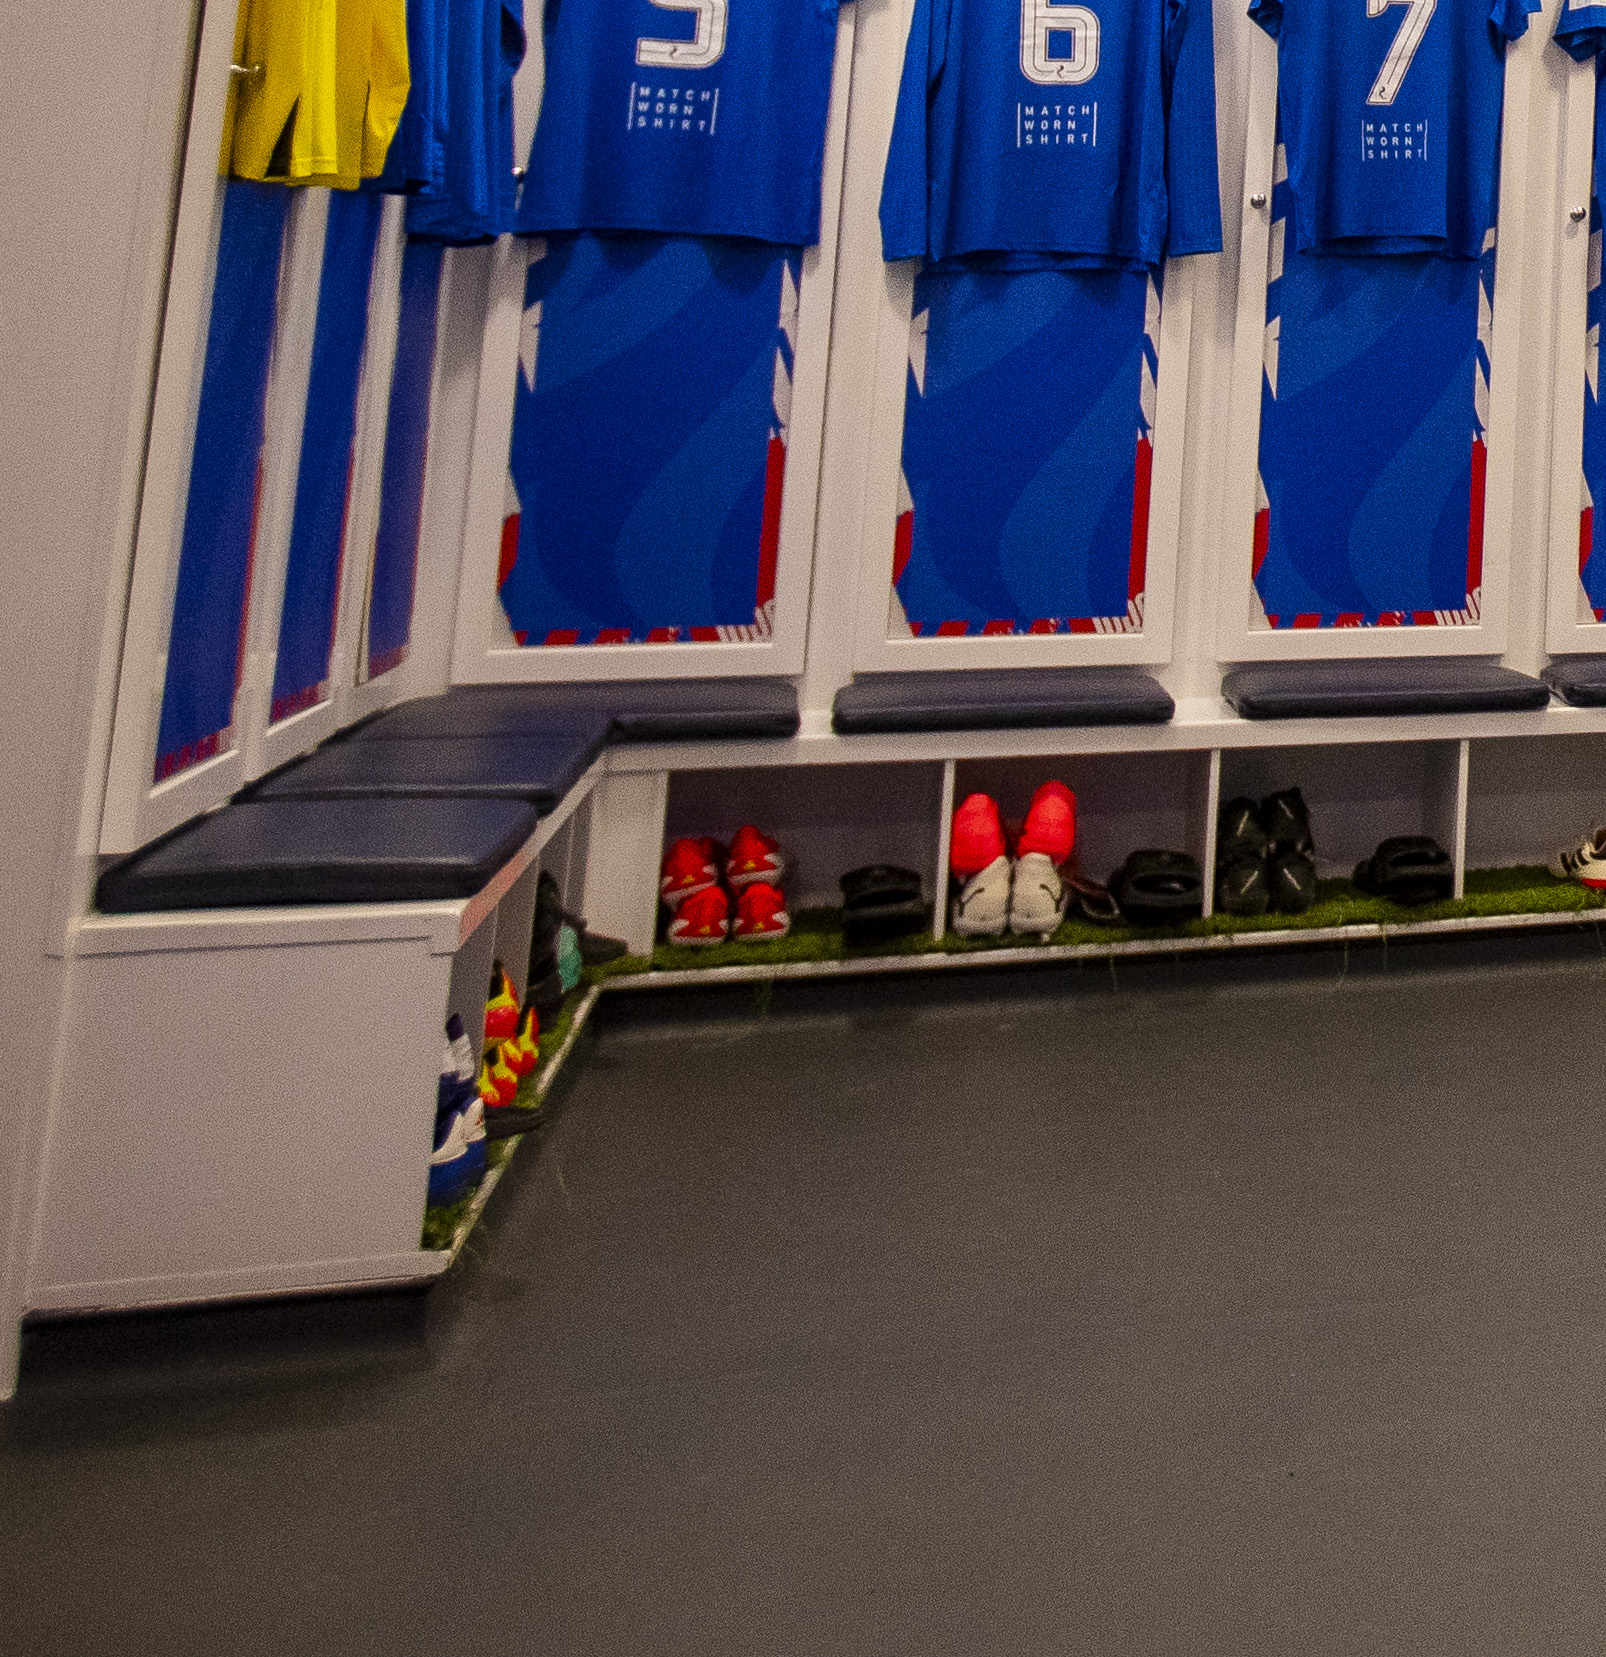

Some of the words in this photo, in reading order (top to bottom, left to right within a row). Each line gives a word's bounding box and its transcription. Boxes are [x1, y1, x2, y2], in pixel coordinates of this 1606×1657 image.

[638, 87, 711, 101] MATCH
[637, 103, 693, 115] WORN
[1025, 105, 1090, 116] MATCH
[637, 117, 706, 130] SHIRT
[1025, 120, 1076, 130] WORN
[1366, 123, 1423, 133] MATCH
[1025, 133, 1089, 145] SHIRT
[1366, 137, 1413, 147] WORN
[1367, 149, 1423, 159] SHIRT
